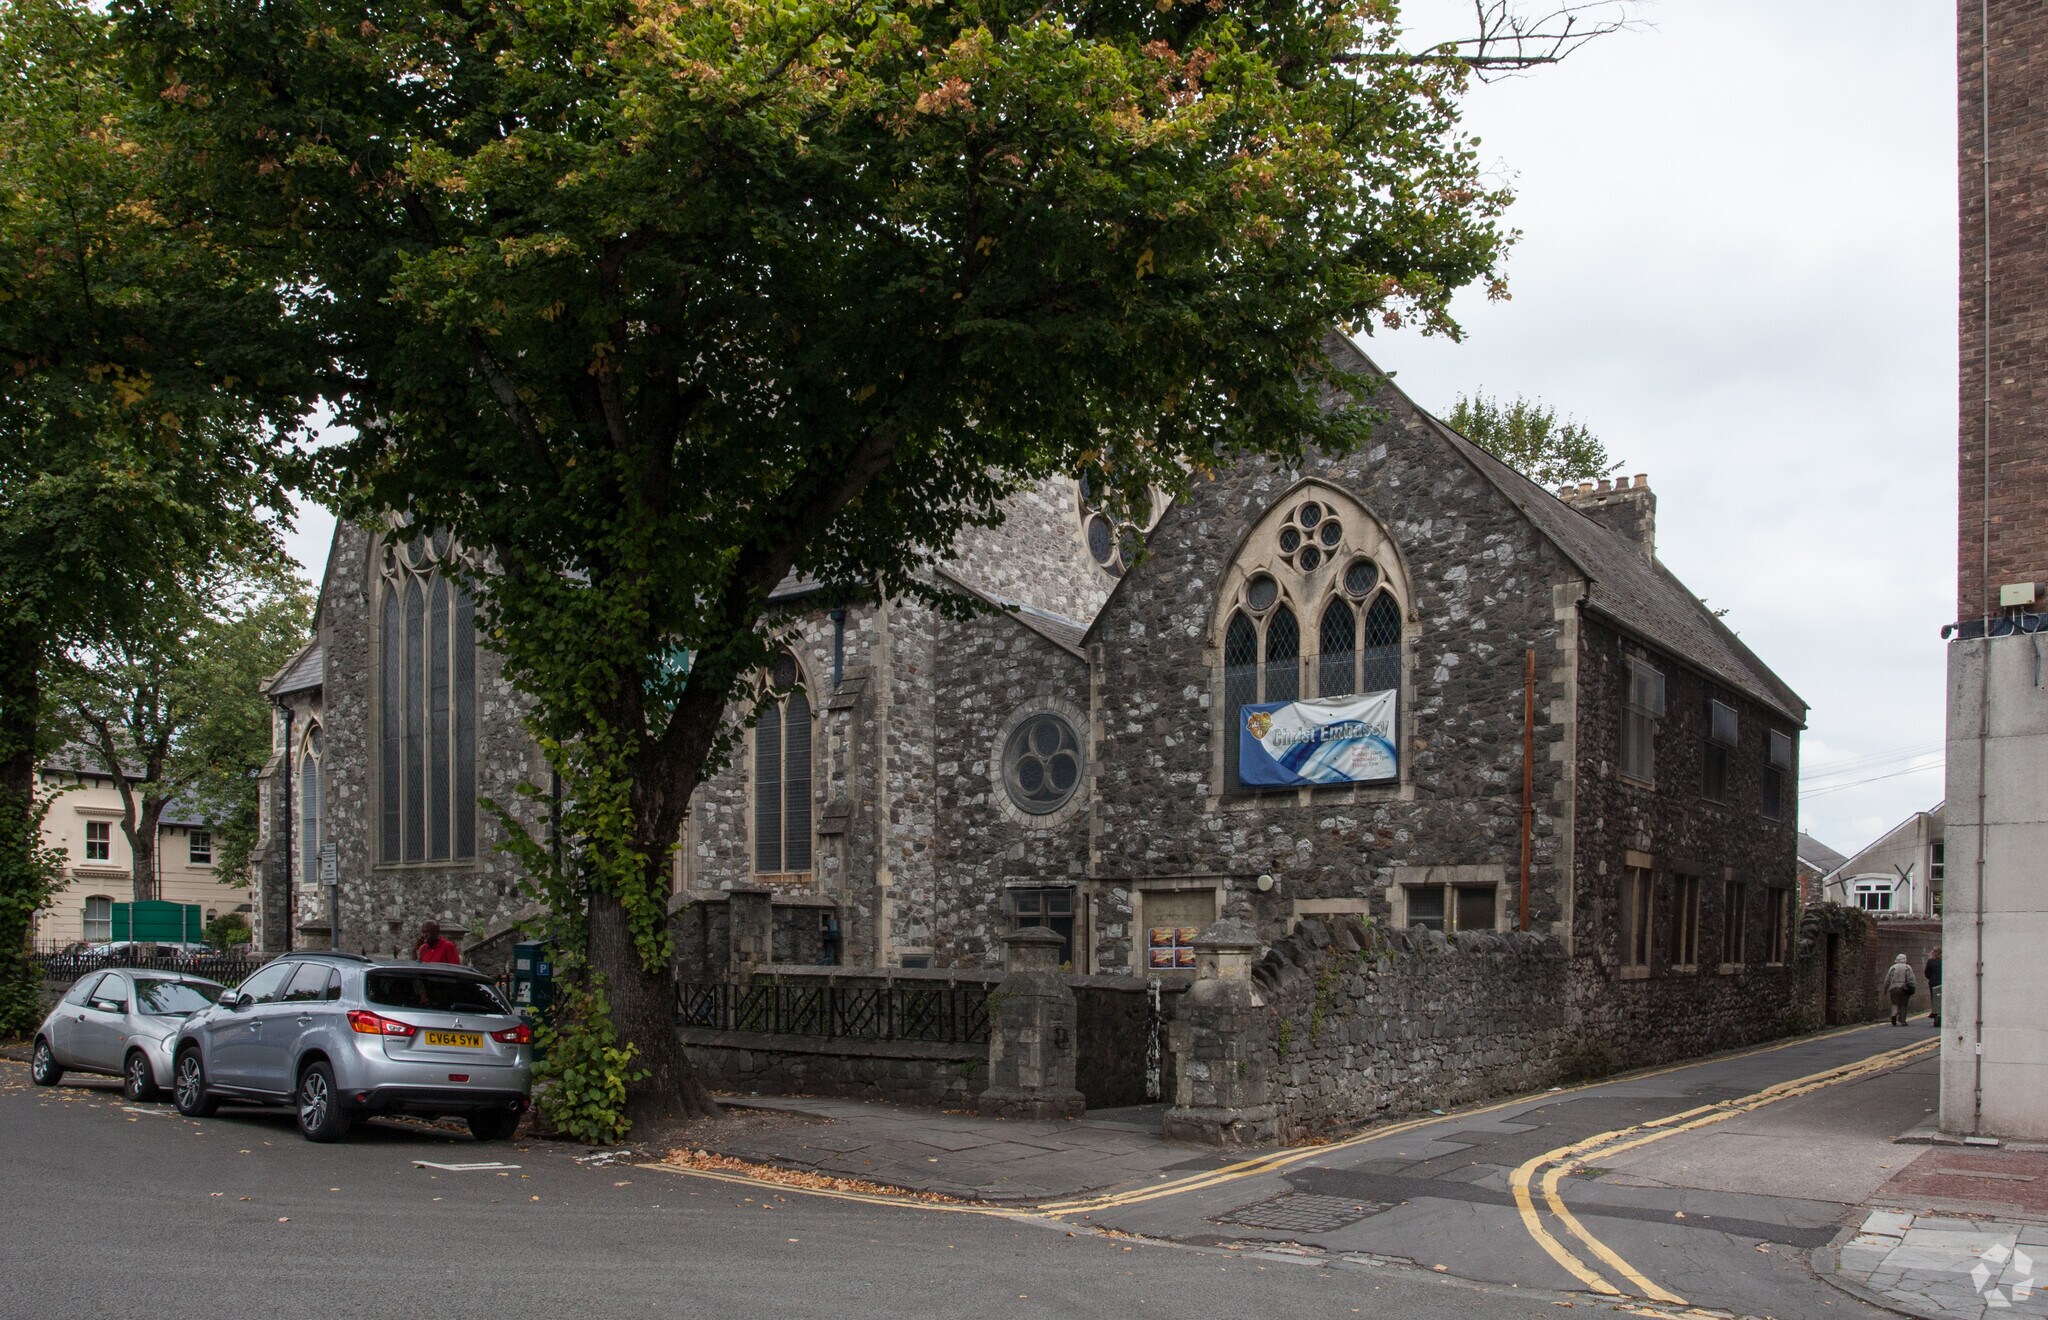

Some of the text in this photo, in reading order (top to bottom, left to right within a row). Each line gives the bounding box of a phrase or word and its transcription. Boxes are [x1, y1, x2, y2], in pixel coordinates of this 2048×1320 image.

[1272, 720, 1389, 746] Christ Embassy
[429, 1033, 480, 1046] CV64 SYW
